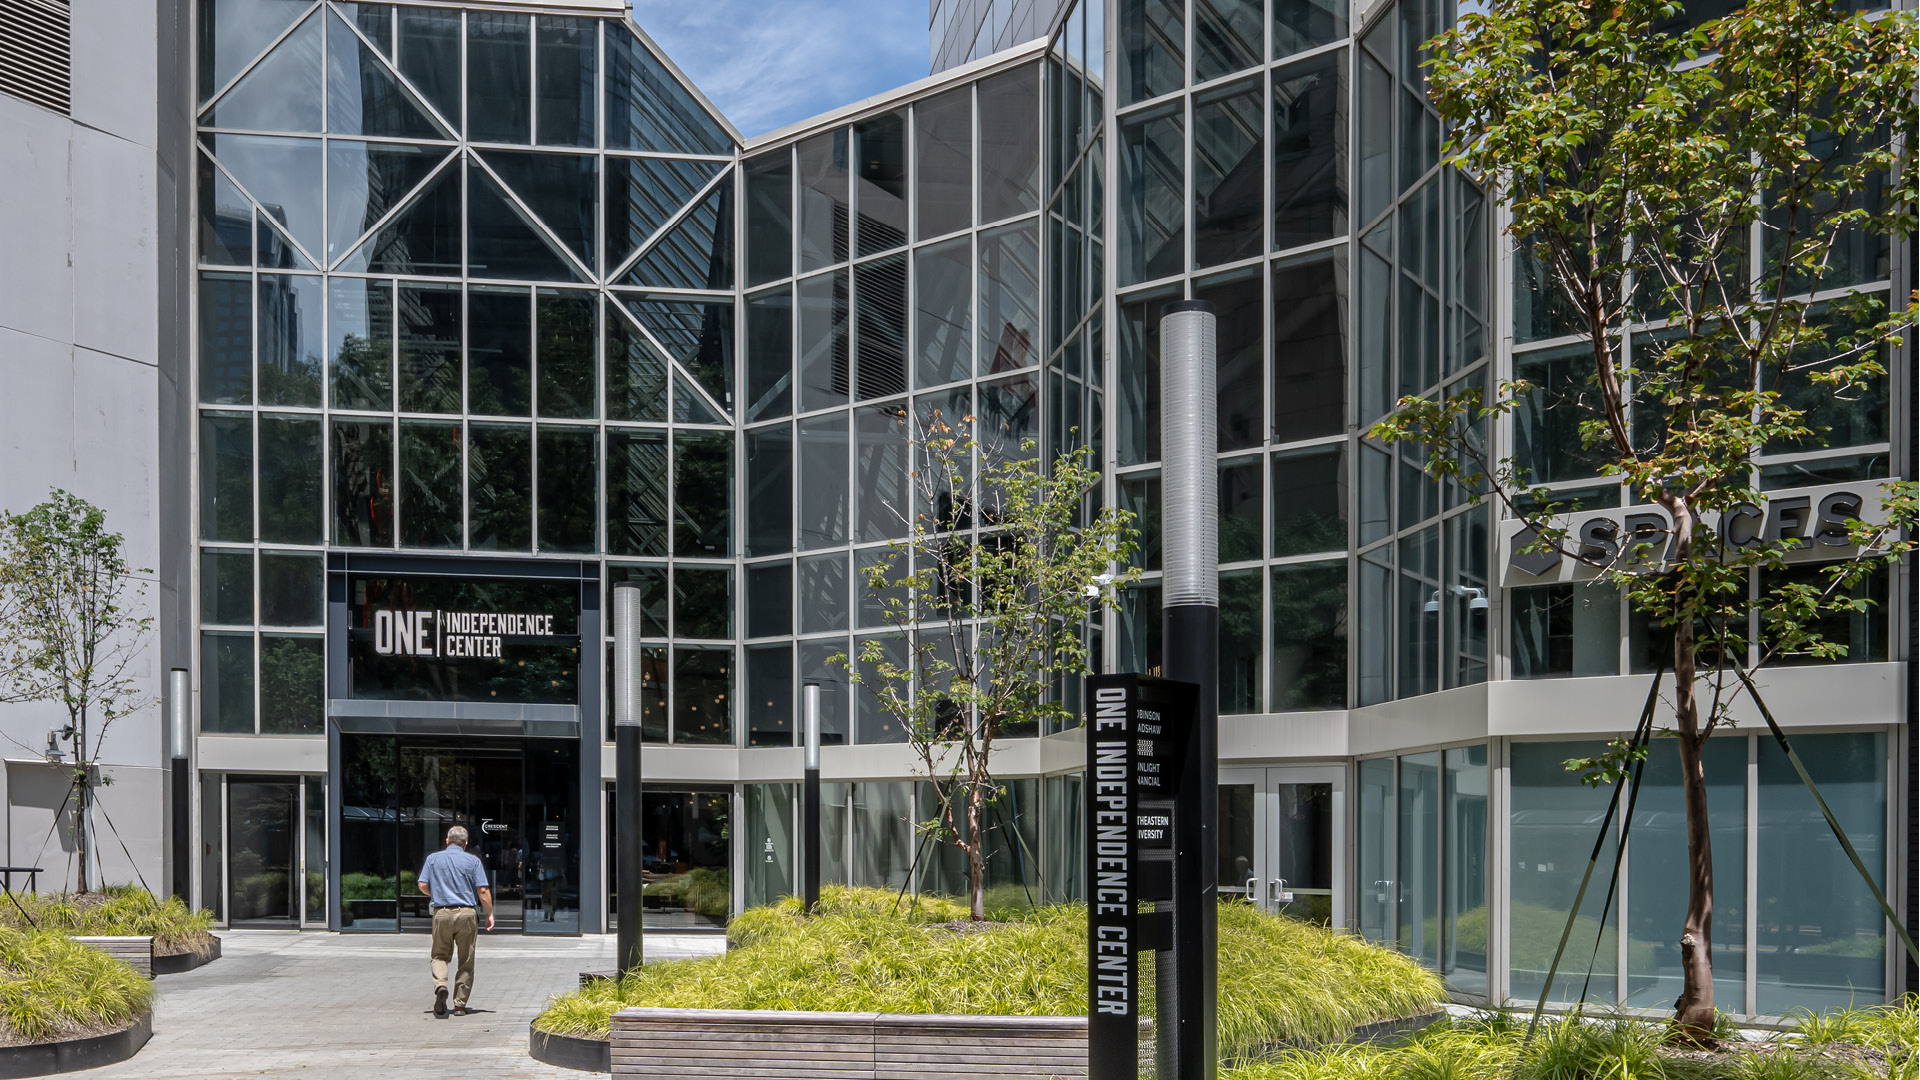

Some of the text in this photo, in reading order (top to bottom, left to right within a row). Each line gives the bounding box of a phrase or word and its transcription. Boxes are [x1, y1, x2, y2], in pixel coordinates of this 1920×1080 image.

[375, 610, 432, 656] ONE
[446, 612, 554, 636] INDEPENDENCE
[446, 635, 502, 657] CENTER
[1137, 723, 1162, 735] ADSHAW
[1138, 829, 1163, 839] IVERSITY
[1096, 688, 1128, 1016] ONE INDEPENDENCE CENTER
